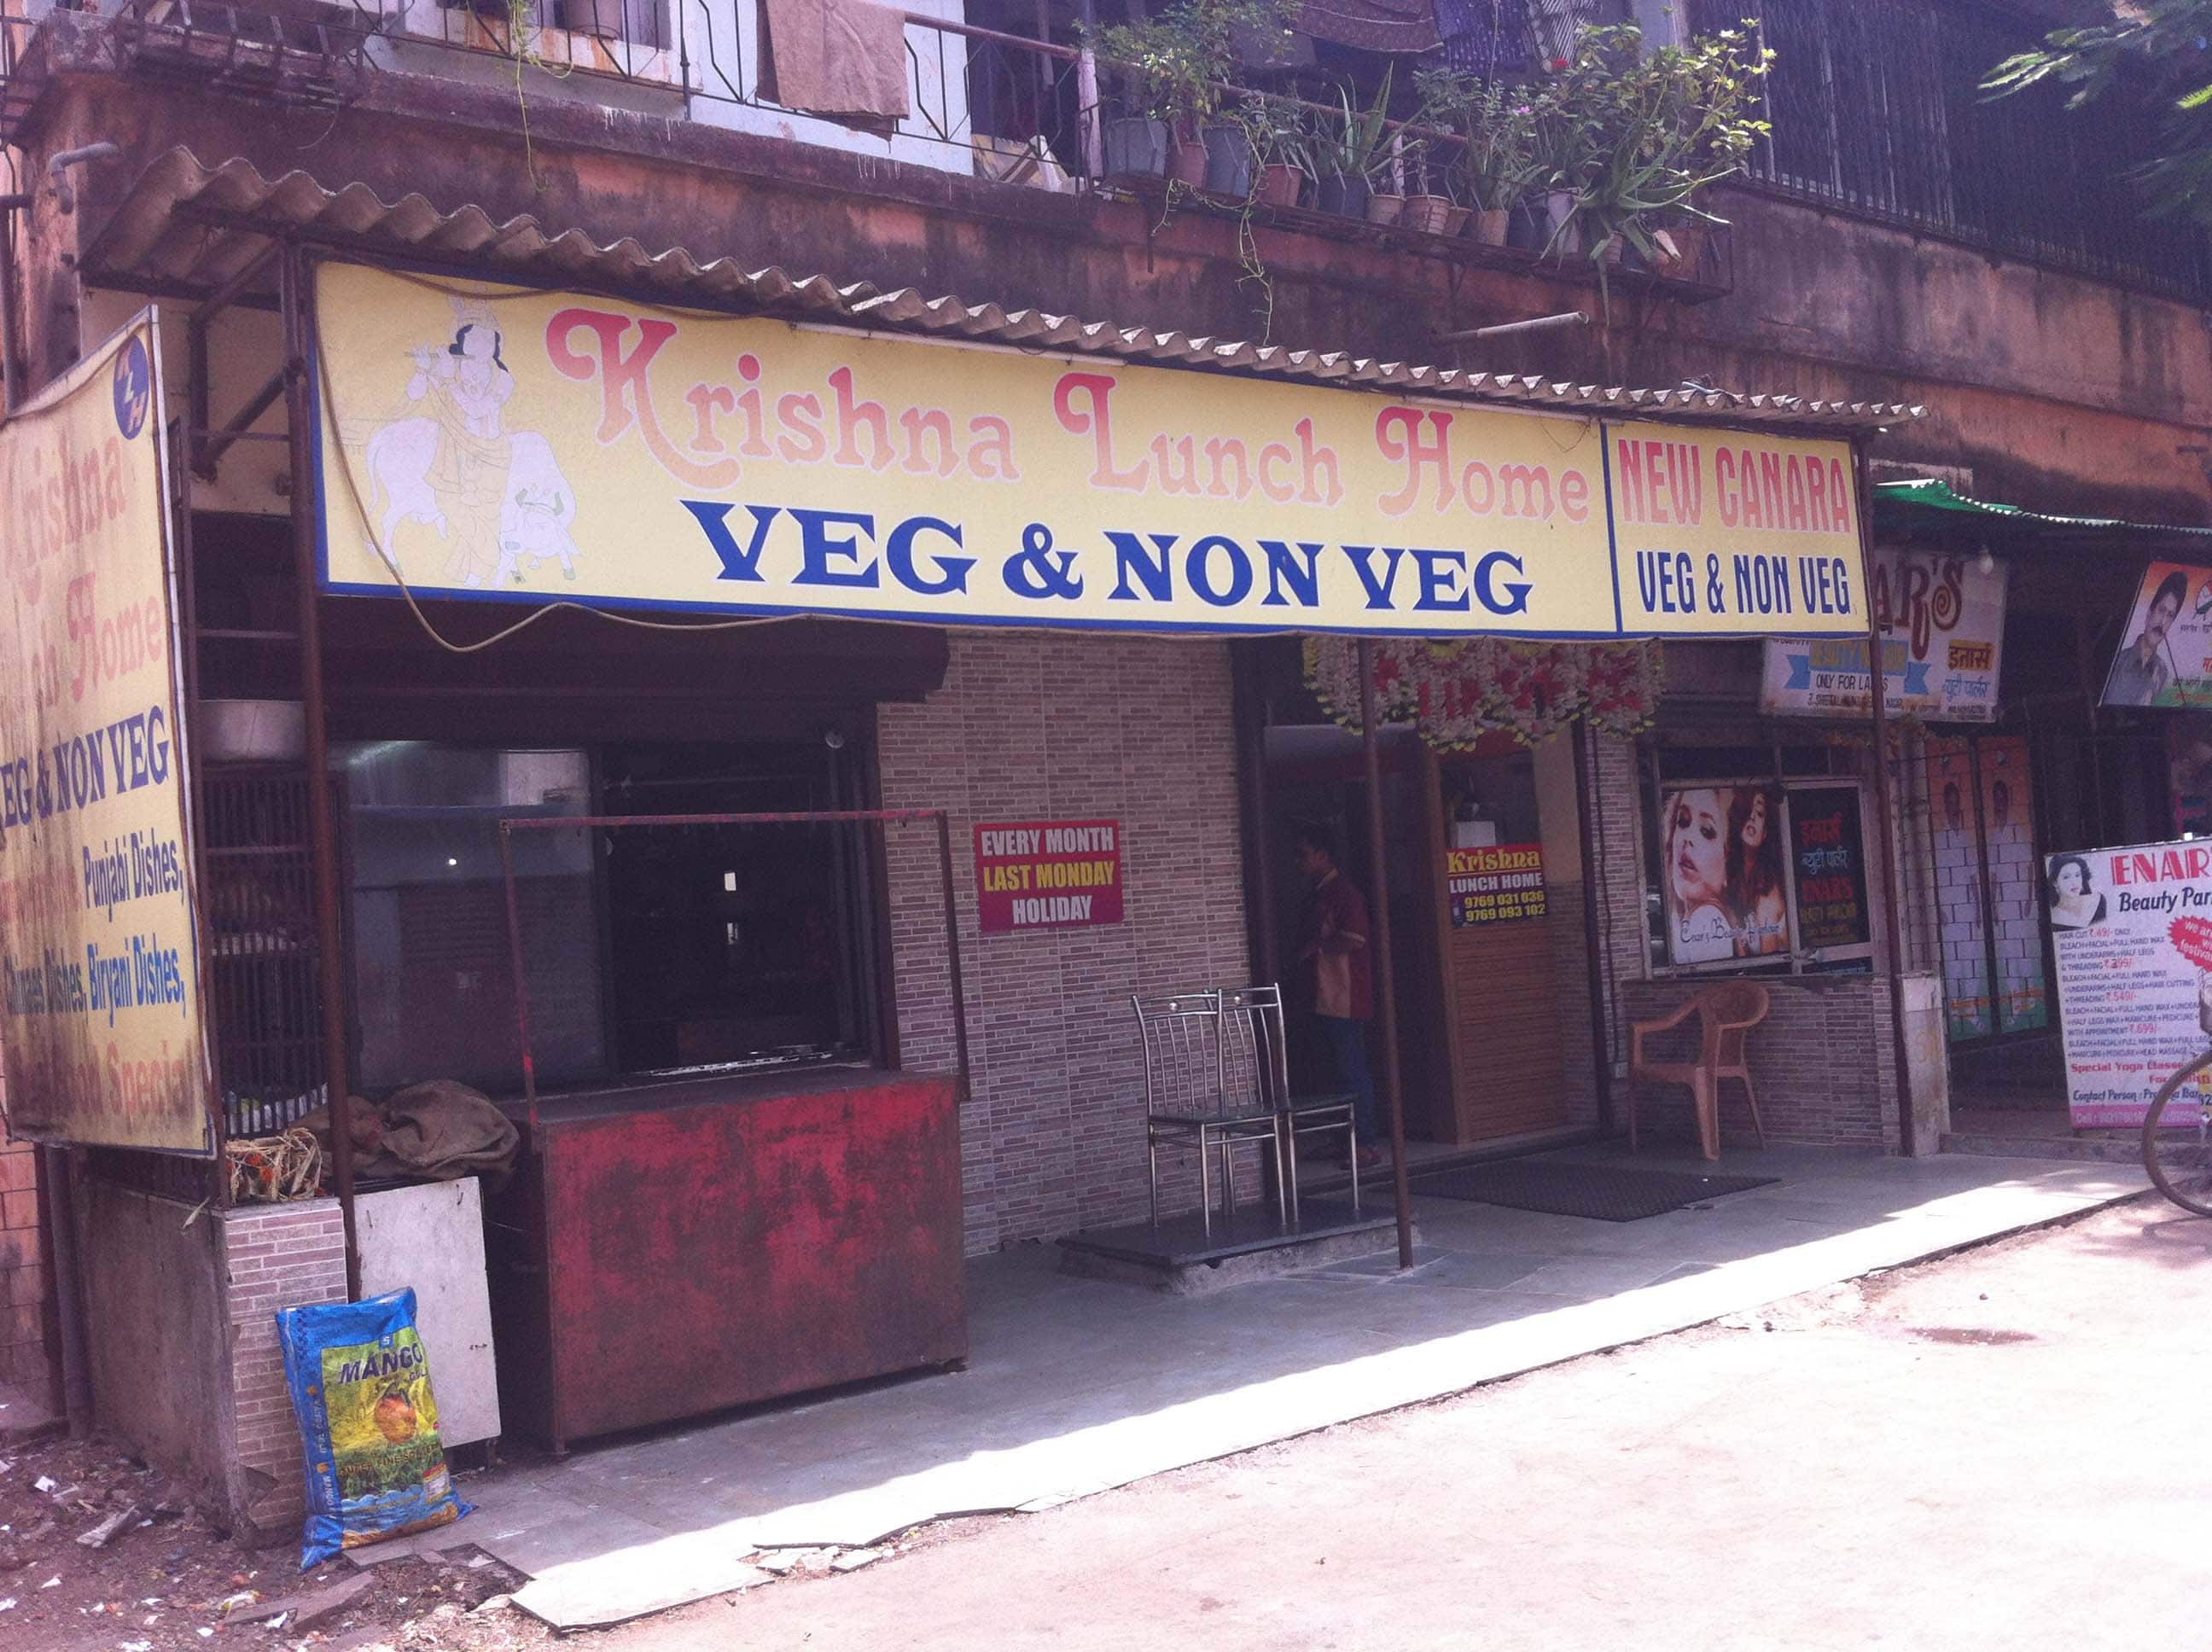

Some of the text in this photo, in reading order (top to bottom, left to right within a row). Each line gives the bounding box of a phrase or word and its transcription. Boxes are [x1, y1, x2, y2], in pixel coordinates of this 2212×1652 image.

[547, 308, 1590, 524] Krishna Lunch Home
[1618, 439, 1852, 533] NEW CANARA
[678, 498, 1534, 615] VEG & NON VEG
[1637, 550, 1850, 614] VEG & NON VEG
[1816, 673, 1835, 689] ONLY
[1837, 674, 1856, 690] FOR
[0, 757, 32, 831] EG
[53, 728, 106, 814] NON
[108, 705, 170, 795] VEG
[981, 826, 1114, 857] EVERY MONTH
[1447, 848, 1541, 873] Krishna
[83, 836, 131, 923] Punjabi
[131, 827, 184, 905] Dishes,
[983, 860, 1115, 892] LAST MONDAY
[1449, 872, 1543, 893] LUNCH HOME
[1012, 894, 1092, 924] HOLIDAY
[1464, 894, 1495, 909] 9769
[1497, 893, 1518, 905] 031
[1465, 904, 1545, 922] 9769 093 102
[2119, 891, 2178, 914] Beauty
[2059, 931, 2074, 939] HAIR
[2185, 921, 2198, 934] We
[87, 937, 132, 1028] Biryani
[132, 933, 187, 1020] Dishes,
[2071, 1062, 2111, 1073] Special
[2115, 1062, 2144, 1073] Yoga
[2074, 1091, 2105, 1103] Contact
[2108, 1089, 2138, 1102] Person
[339, 1342, 424, 1384] MANGO
[377, 1455, 400, 1468] FINE
